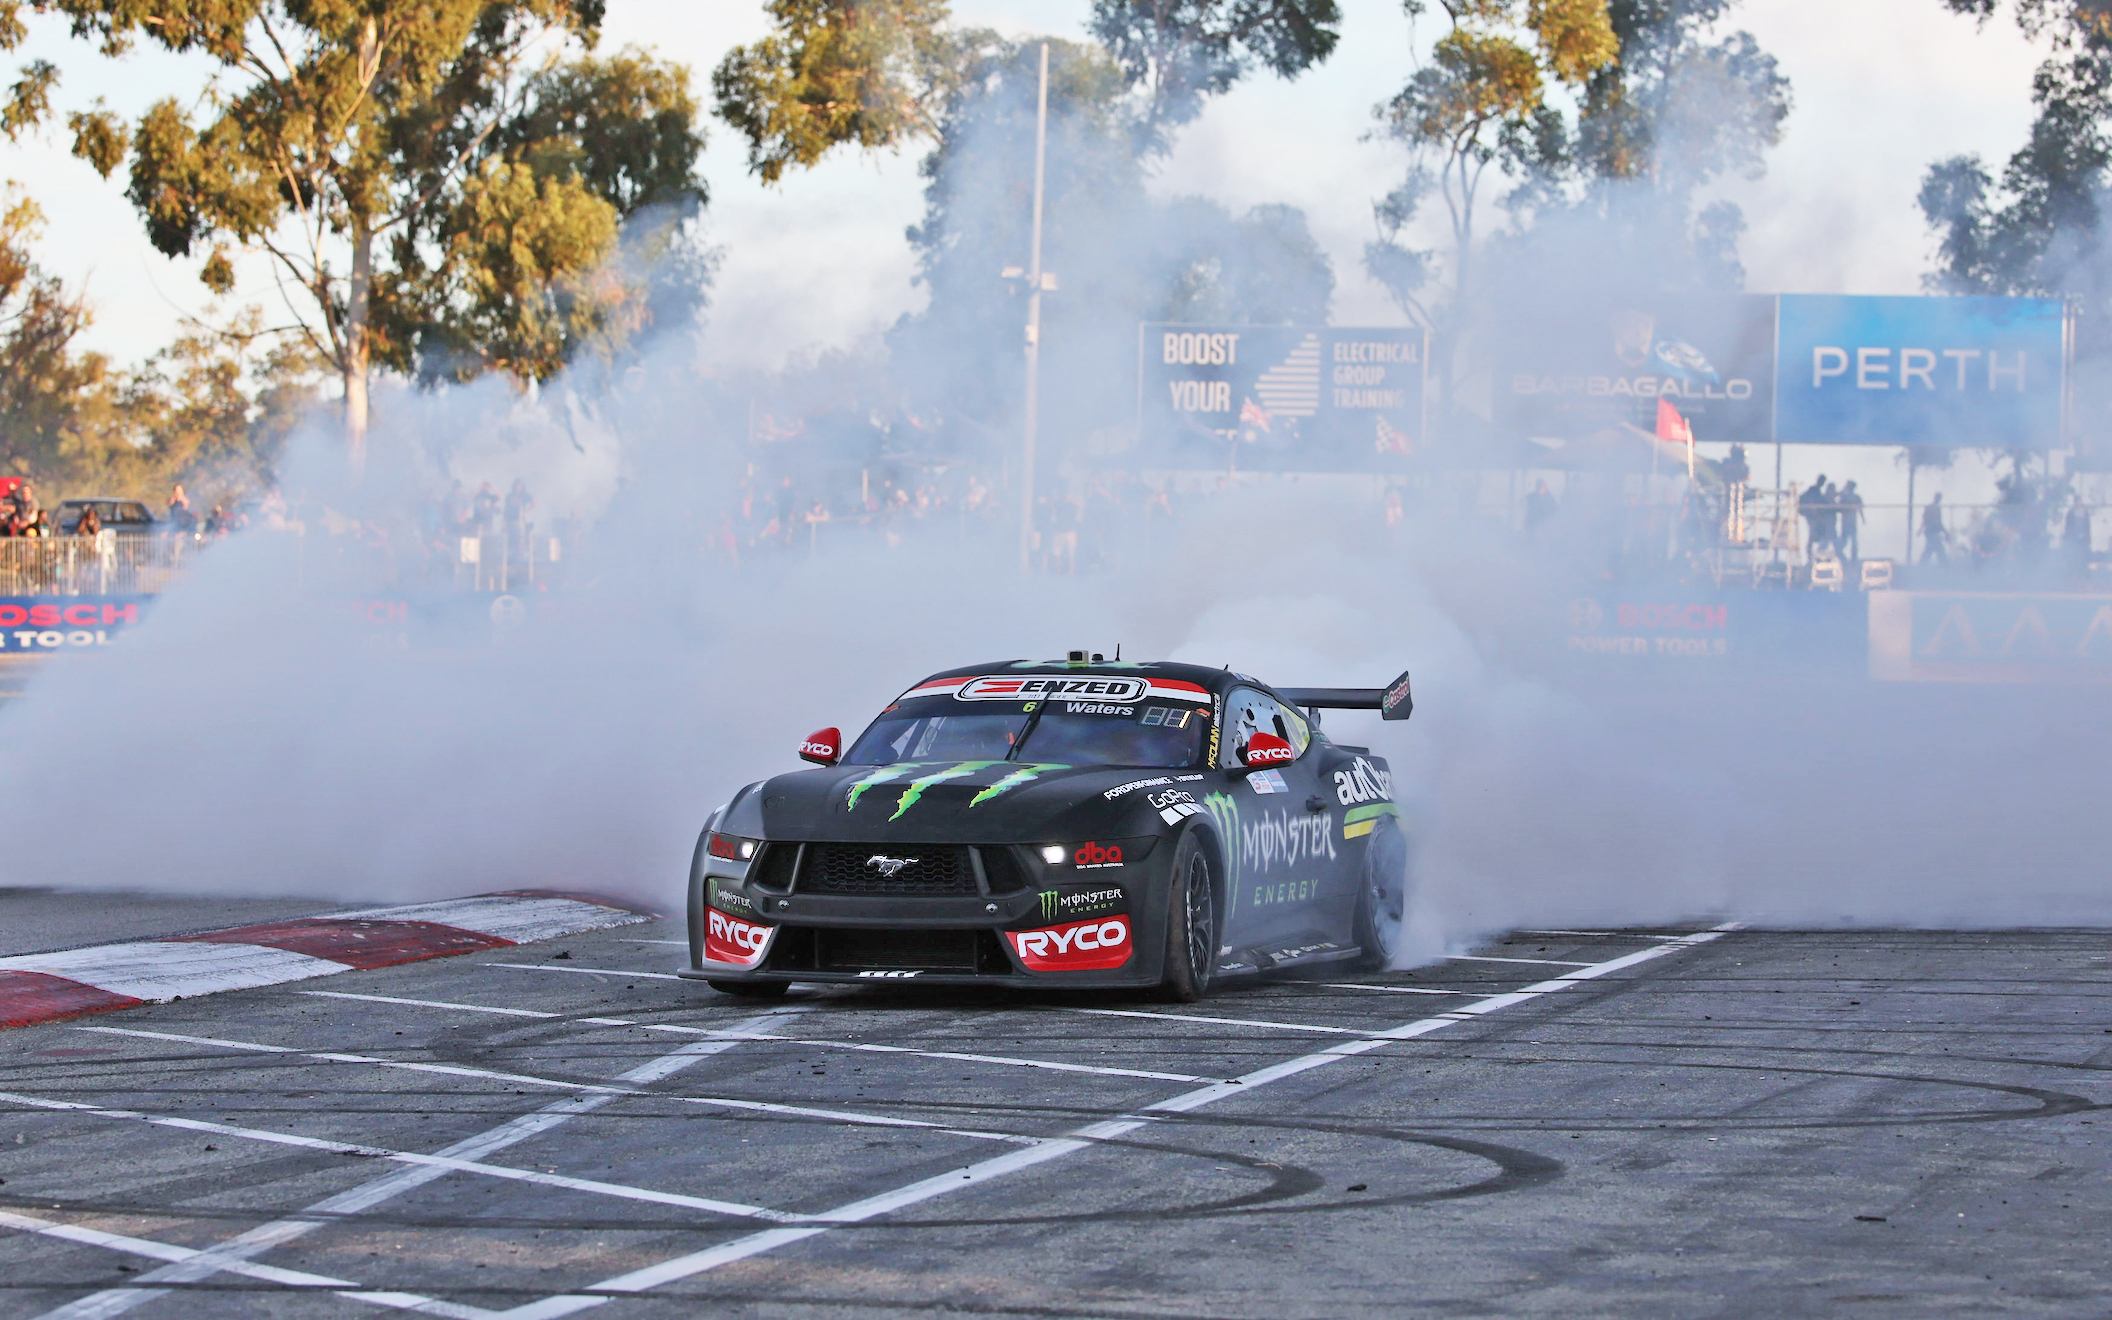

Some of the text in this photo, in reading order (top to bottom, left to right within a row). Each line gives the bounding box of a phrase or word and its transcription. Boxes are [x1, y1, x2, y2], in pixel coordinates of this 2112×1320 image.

[1163, 333, 1239, 365] BOOST
[1333, 342, 1418, 363] ELECTRICAL
[1333, 366, 1386, 385] GROUP
[1813, 346, 2027, 392] PERTH
[1169, 380, 1231, 412] YOUR
[1513, 374, 1752, 400] BARBAGALLO
[1333, 388, 1404, 408] TRAINING
[0, 603, 138, 627] OSCH
[1617, 603, 1728, 629] BOSCH
[13, 631, 115, 647] TOOL
[1567, 636, 1727, 655] POWER TOOLS
[1020, 681, 1131, 695] ENZED
[1023, 702, 1036, 712] 6
[1066, 702, 1134, 715] Waters
[799, 741, 833, 755] RYCO
[1247, 748, 1291, 761] RYCO
[1146, 788, 1196, 809] GoPro
[709, 834, 735, 858] dba
[1242, 806, 1337, 874] MONSTER
[1075, 841, 1122, 864] dba
[1060, 888, 1122, 906] MONSTER
[1254, 879, 1318, 907] ENERGY
[723, 904, 748, 914] ENERGY
[1070, 902, 1114, 914] ENERGY
[709, 910, 768, 952] RYCO
[1017, 921, 1126, 958] RYCO
